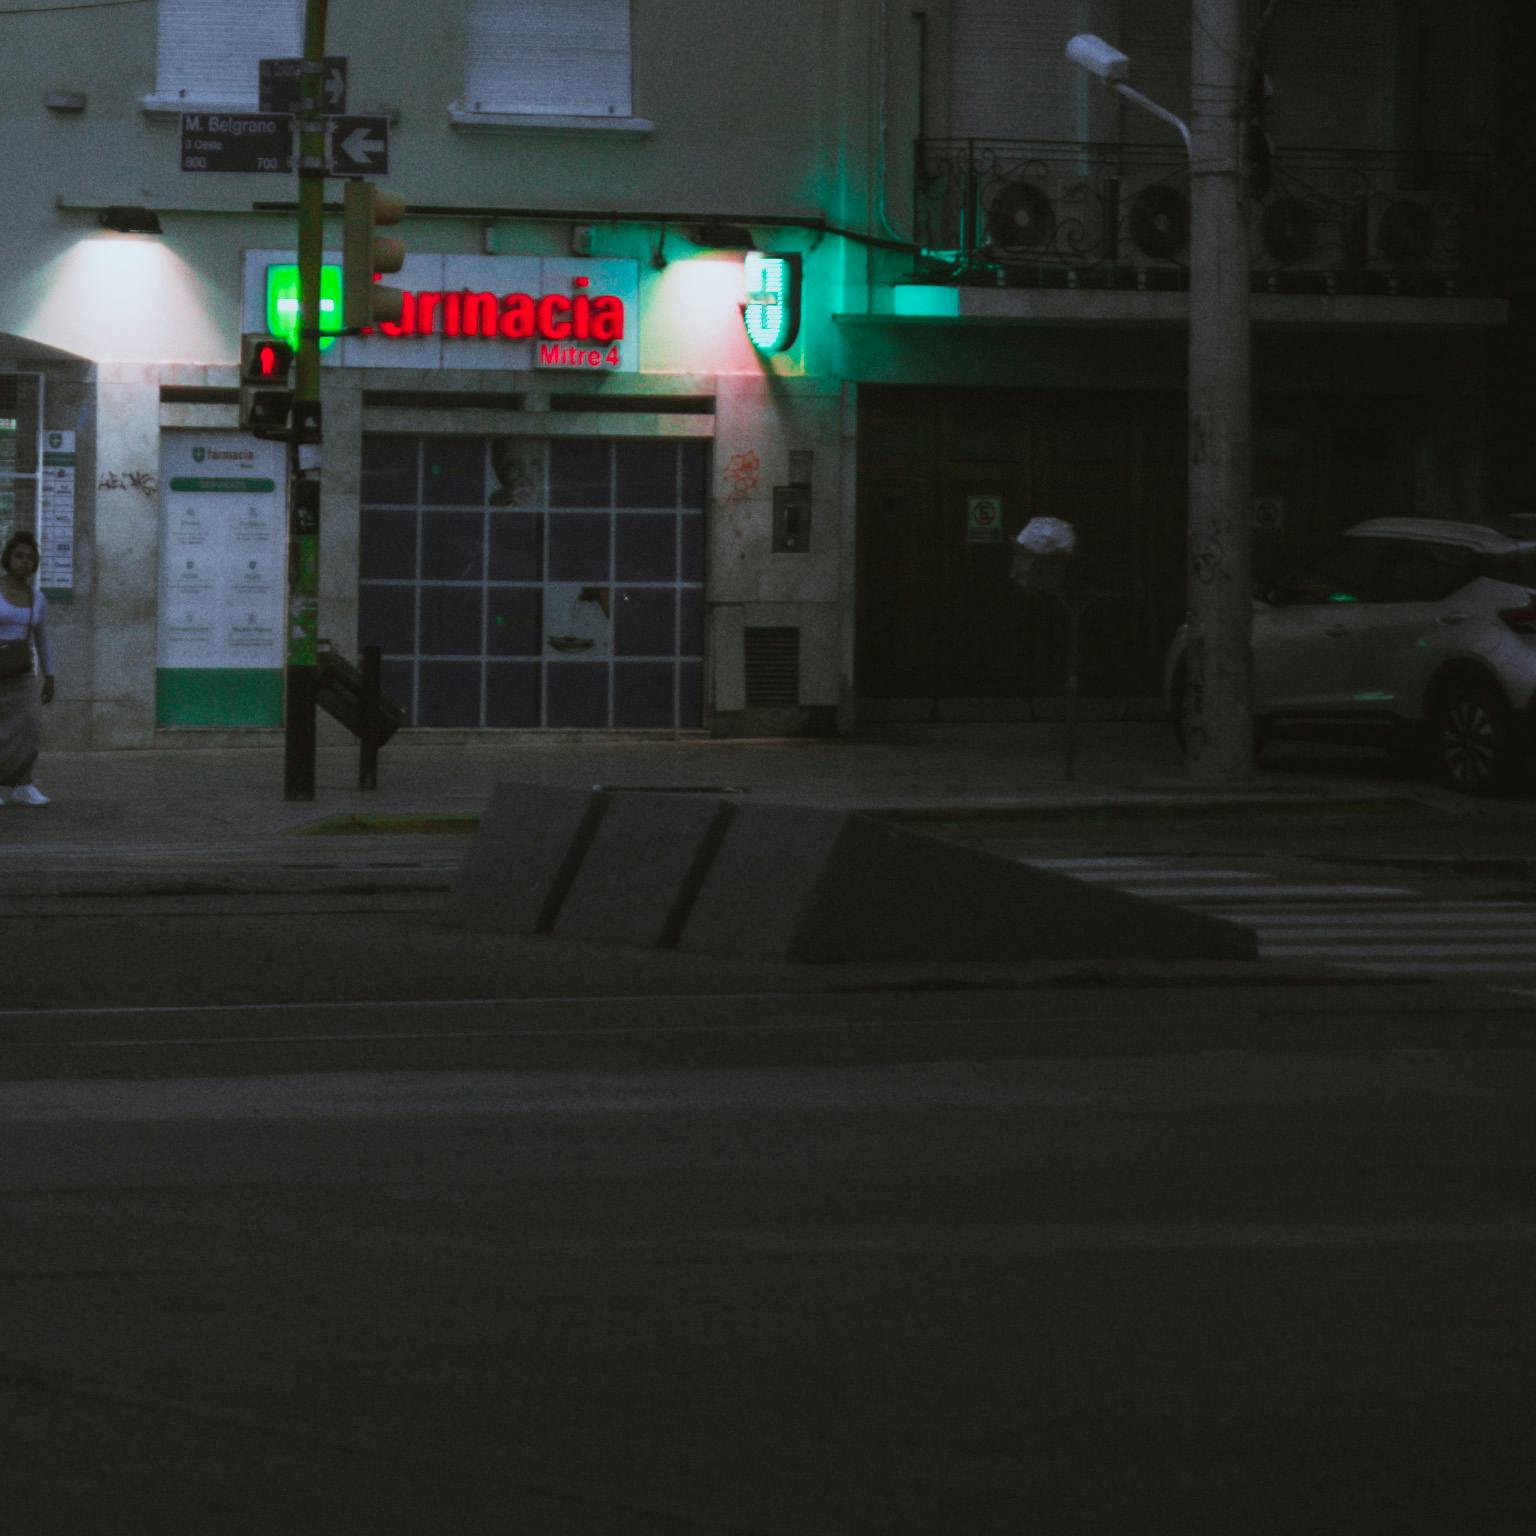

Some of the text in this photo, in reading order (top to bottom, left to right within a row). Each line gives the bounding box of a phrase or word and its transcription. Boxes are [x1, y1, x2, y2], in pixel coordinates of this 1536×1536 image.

[185, 116, 275, 136] M. Belgrano
[256, 157, 278, 170] 700
[360, 272, 624, 341] armacia
[539, 343, 620, 367] Mitre 4
